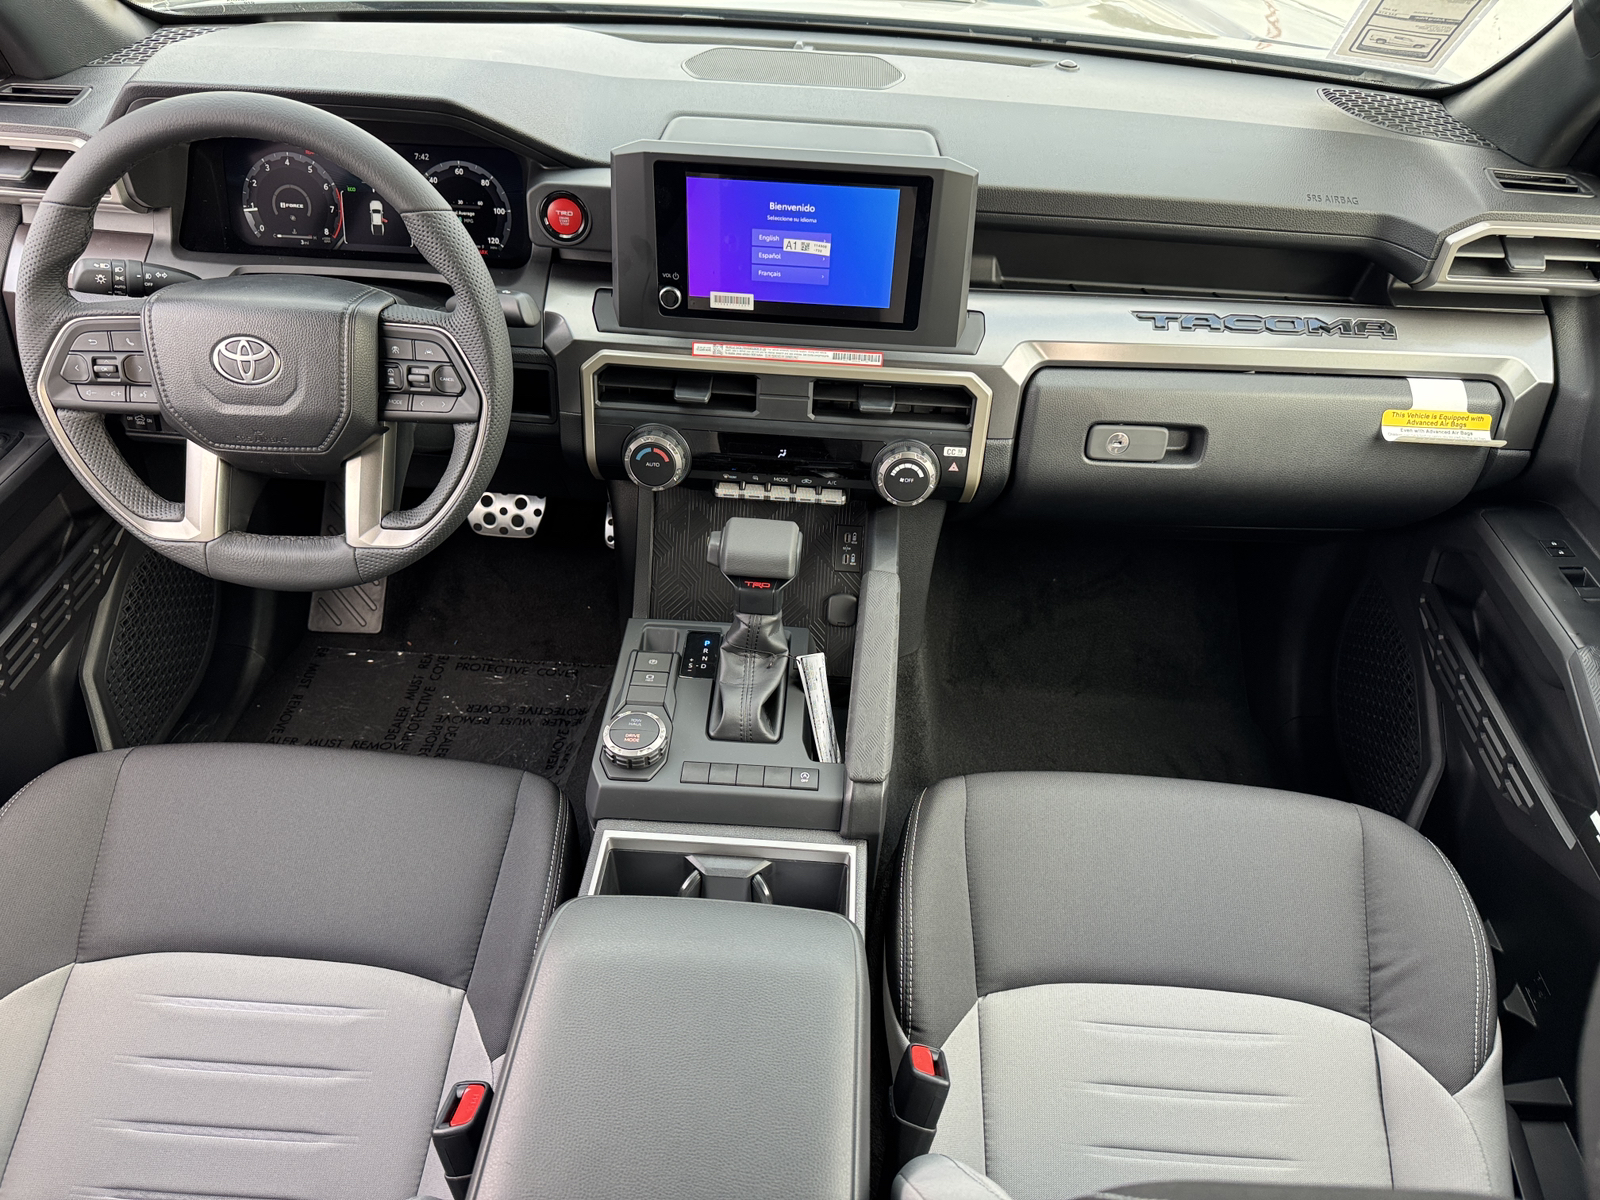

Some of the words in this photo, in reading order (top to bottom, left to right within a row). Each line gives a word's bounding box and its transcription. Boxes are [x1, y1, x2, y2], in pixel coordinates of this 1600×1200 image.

[414, 152, 430, 160] 7:42
[1306, 194, 1322, 202] SRS
[1325, 194, 1359, 205] AIRBAG
[769, 202, 816, 212] Bienvenido
[759, 234, 780, 242] English
[786, 241, 797, 250] A1
[1129, 310, 1398, 340] TACOMA
[1451, 421, 1467, 429] Bags
[744, 580, 770, 588] TRD
[298, 662, 320, 689] MUST
[454, 662, 529, 675] PROTECTIVE
[537, 668, 579, 678] COVER
[401, 686, 436, 742] PROTECTIVE
[430, 656, 450, 681] COVE
[384, 706, 411, 740] DEALER
[405, 674, 424, 700] MUST
[466, 704, 510, 714] COVER
[272, 694, 304, 734] REMOVE
[434, 714, 491, 725] REMOVE
[497, 717, 533, 726] MUST
[266, 736, 299, 745] ALER
[305, 738, 345, 748] MUST
[351, 740, 410, 751] REMOVE
